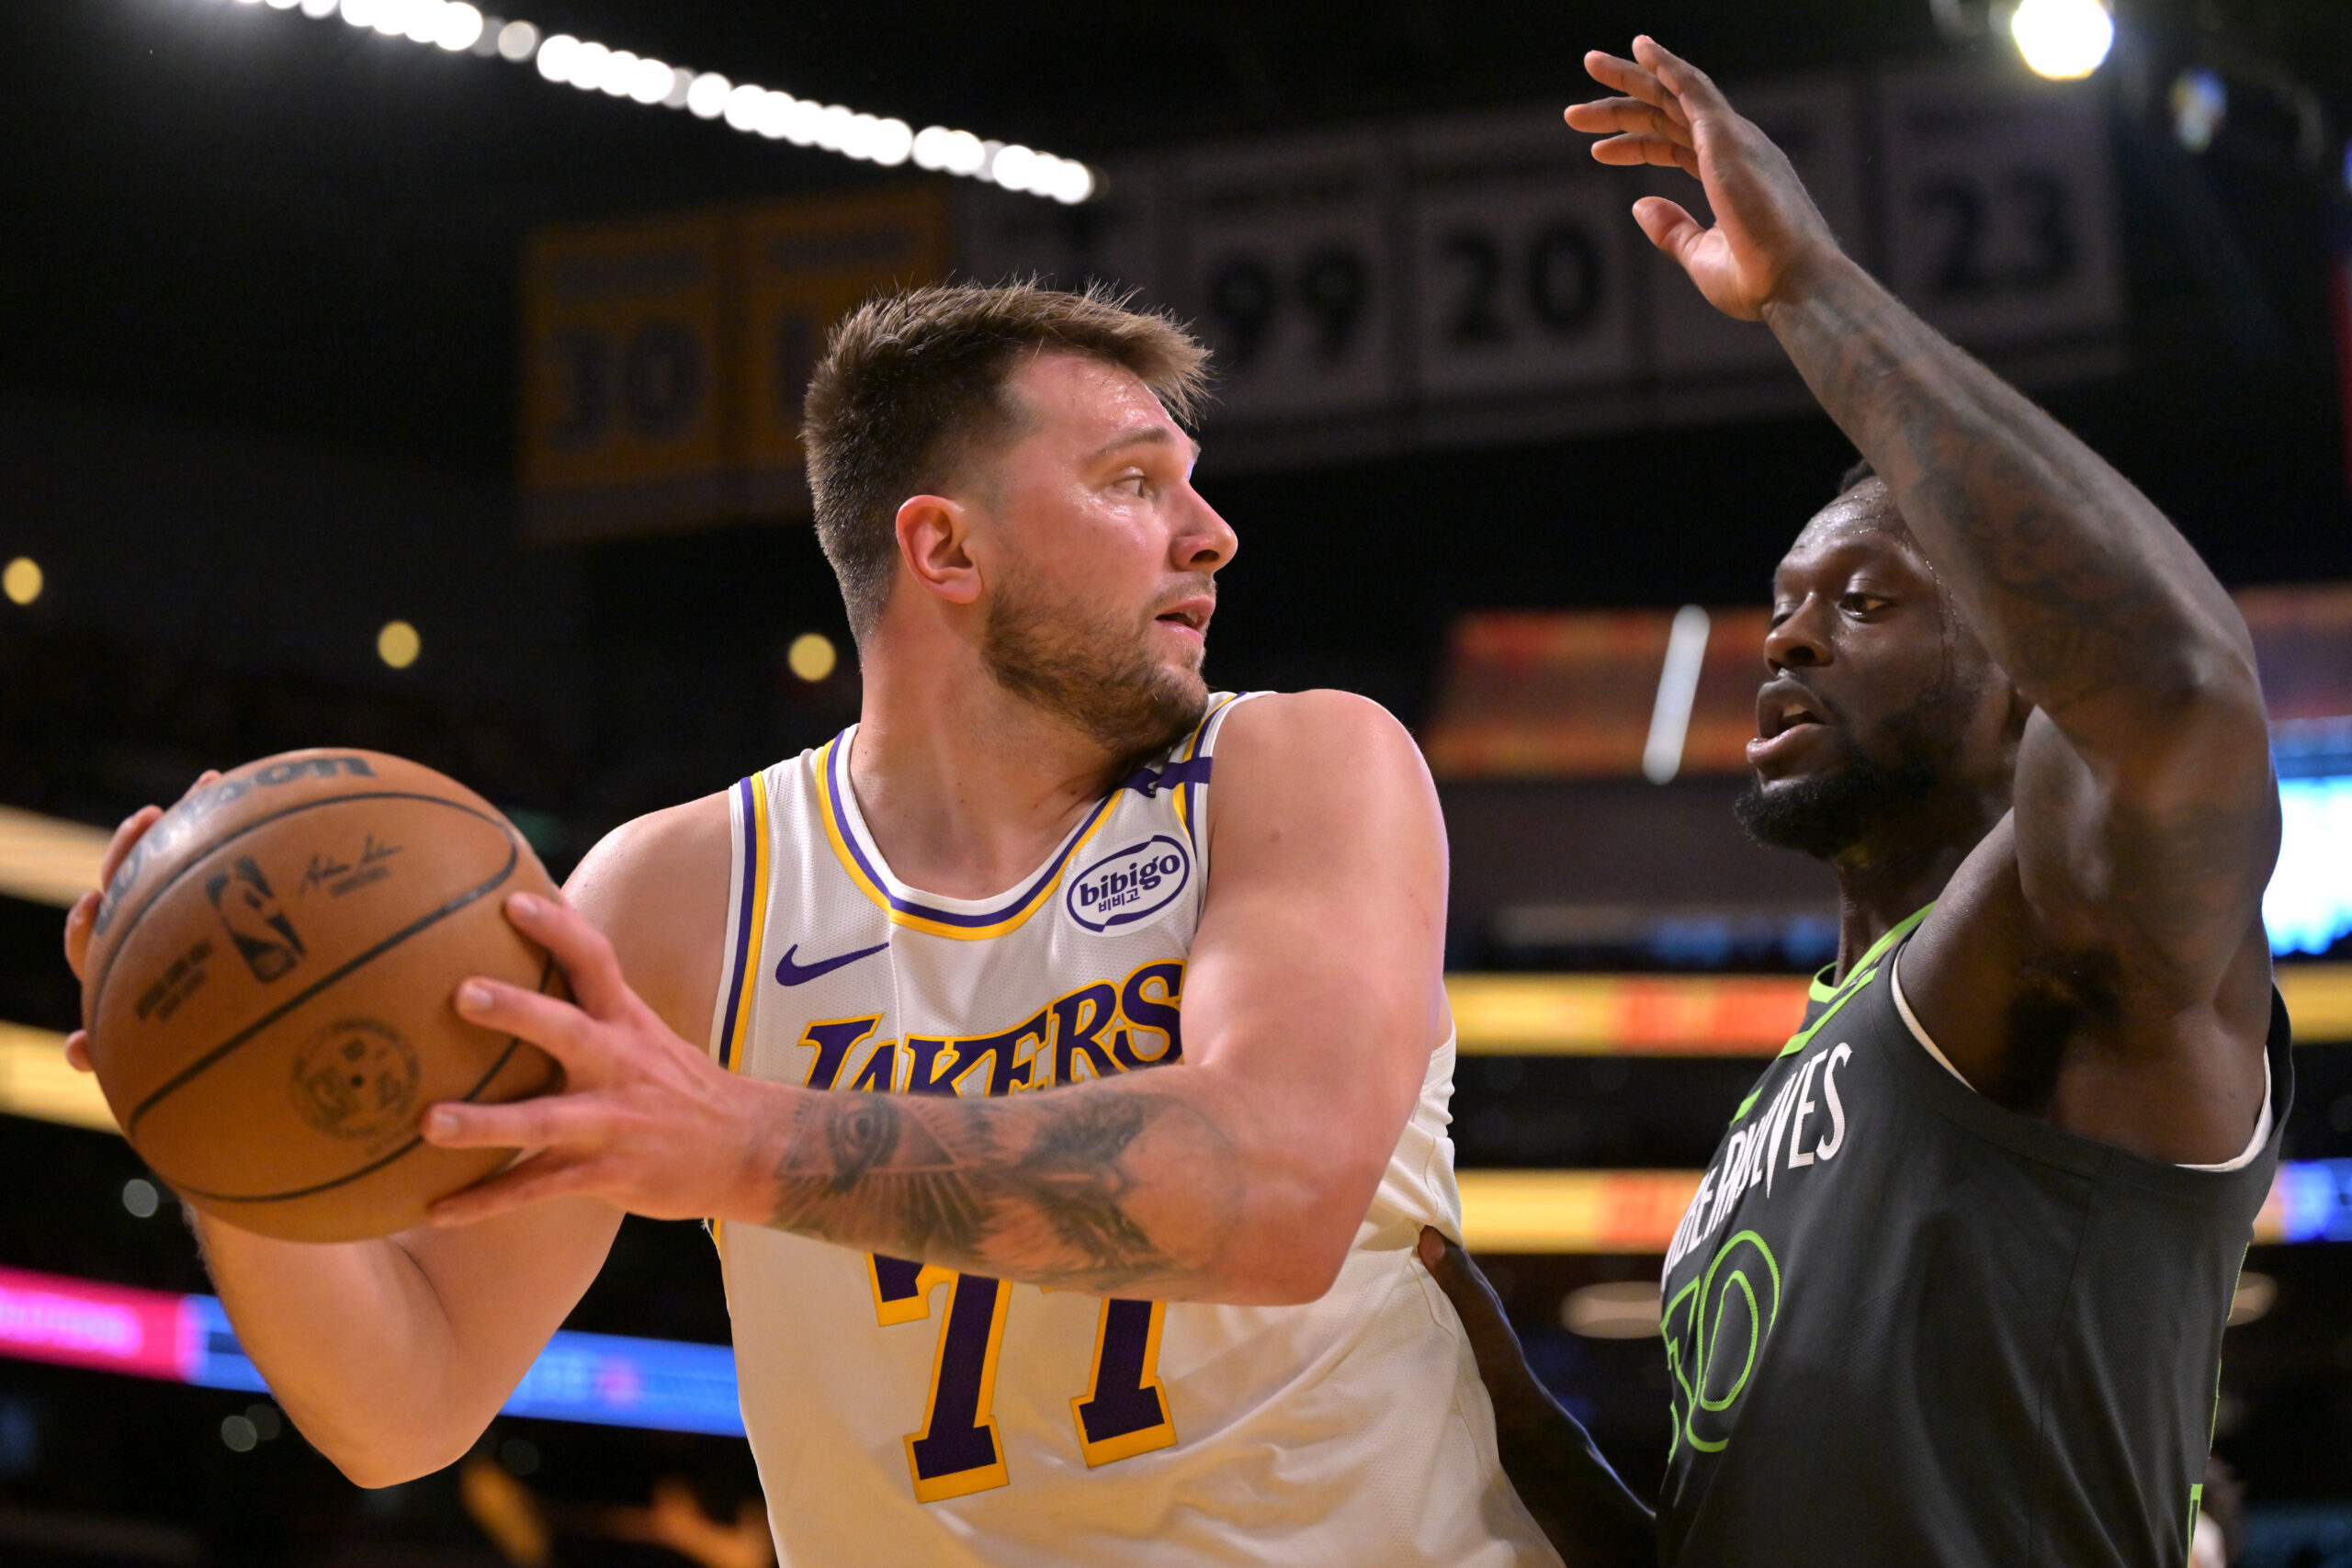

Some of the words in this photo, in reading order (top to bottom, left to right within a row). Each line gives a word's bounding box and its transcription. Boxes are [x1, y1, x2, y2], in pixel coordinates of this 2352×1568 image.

[1442, 219, 1603, 343] 20
[1919, 172, 2074, 294] 23
[1209, 241, 1368, 361] 99
[1080, 854, 1181, 908] bibigo
[1098, 887, 1141, 913] 비비고
[797, 958, 1186, 1097] LAKERS
